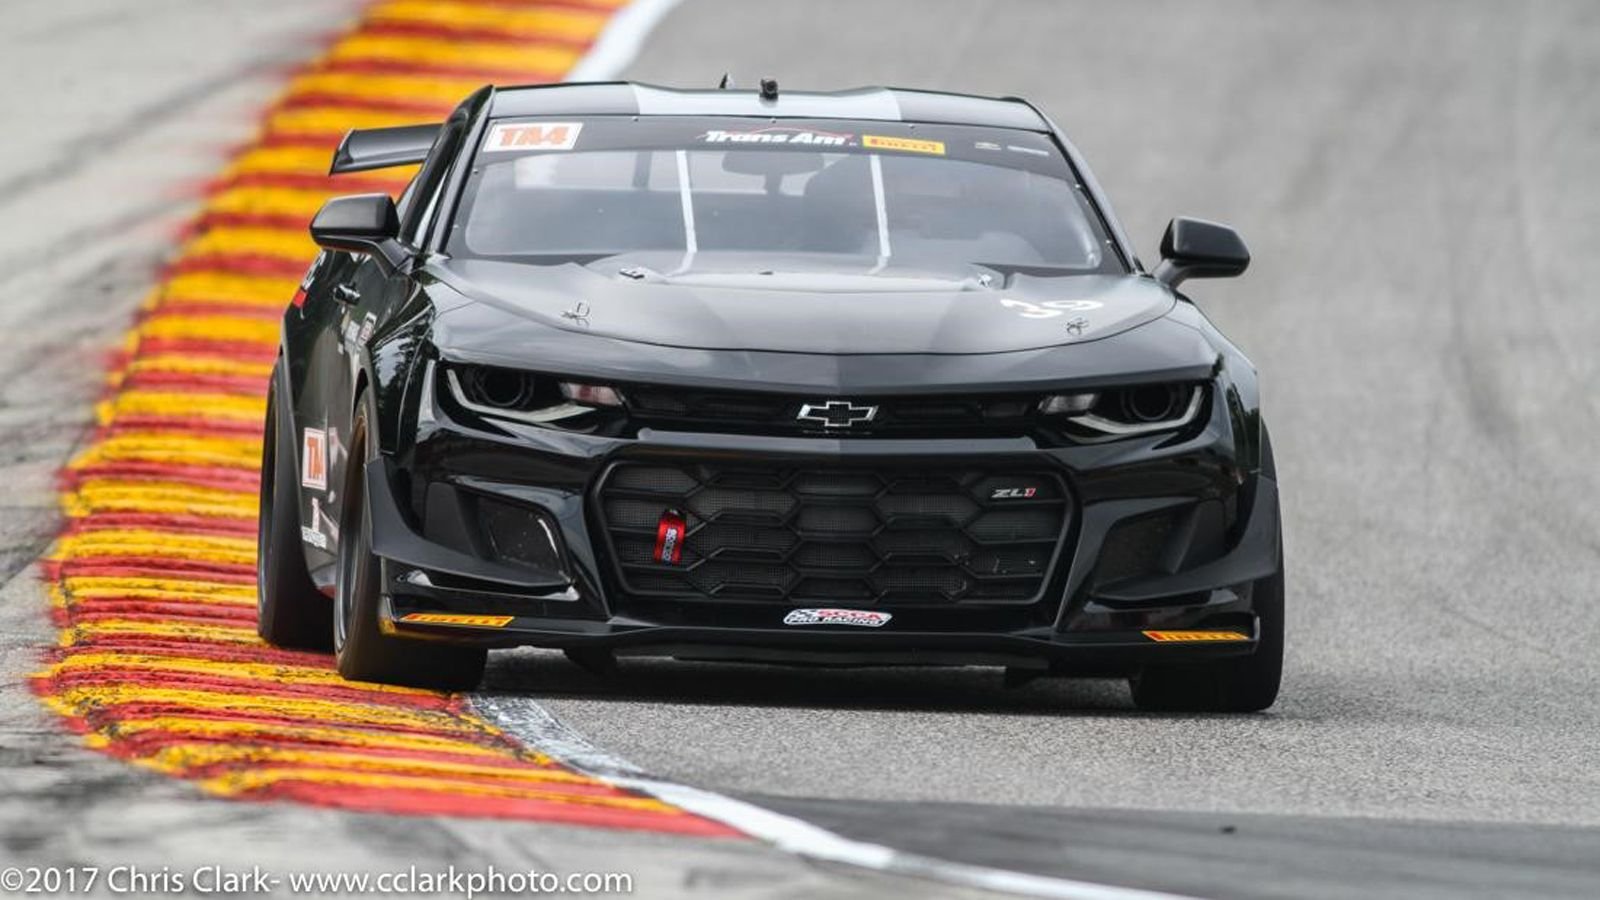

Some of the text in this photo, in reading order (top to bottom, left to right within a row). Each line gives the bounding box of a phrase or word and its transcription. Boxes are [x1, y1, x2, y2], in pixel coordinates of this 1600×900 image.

[500, 126, 569, 147] TA4
[705, 130, 846, 145] Trans Am
[1000, 298, 1105, 319] 39
[991, 487, 1036, 498] ZL1
